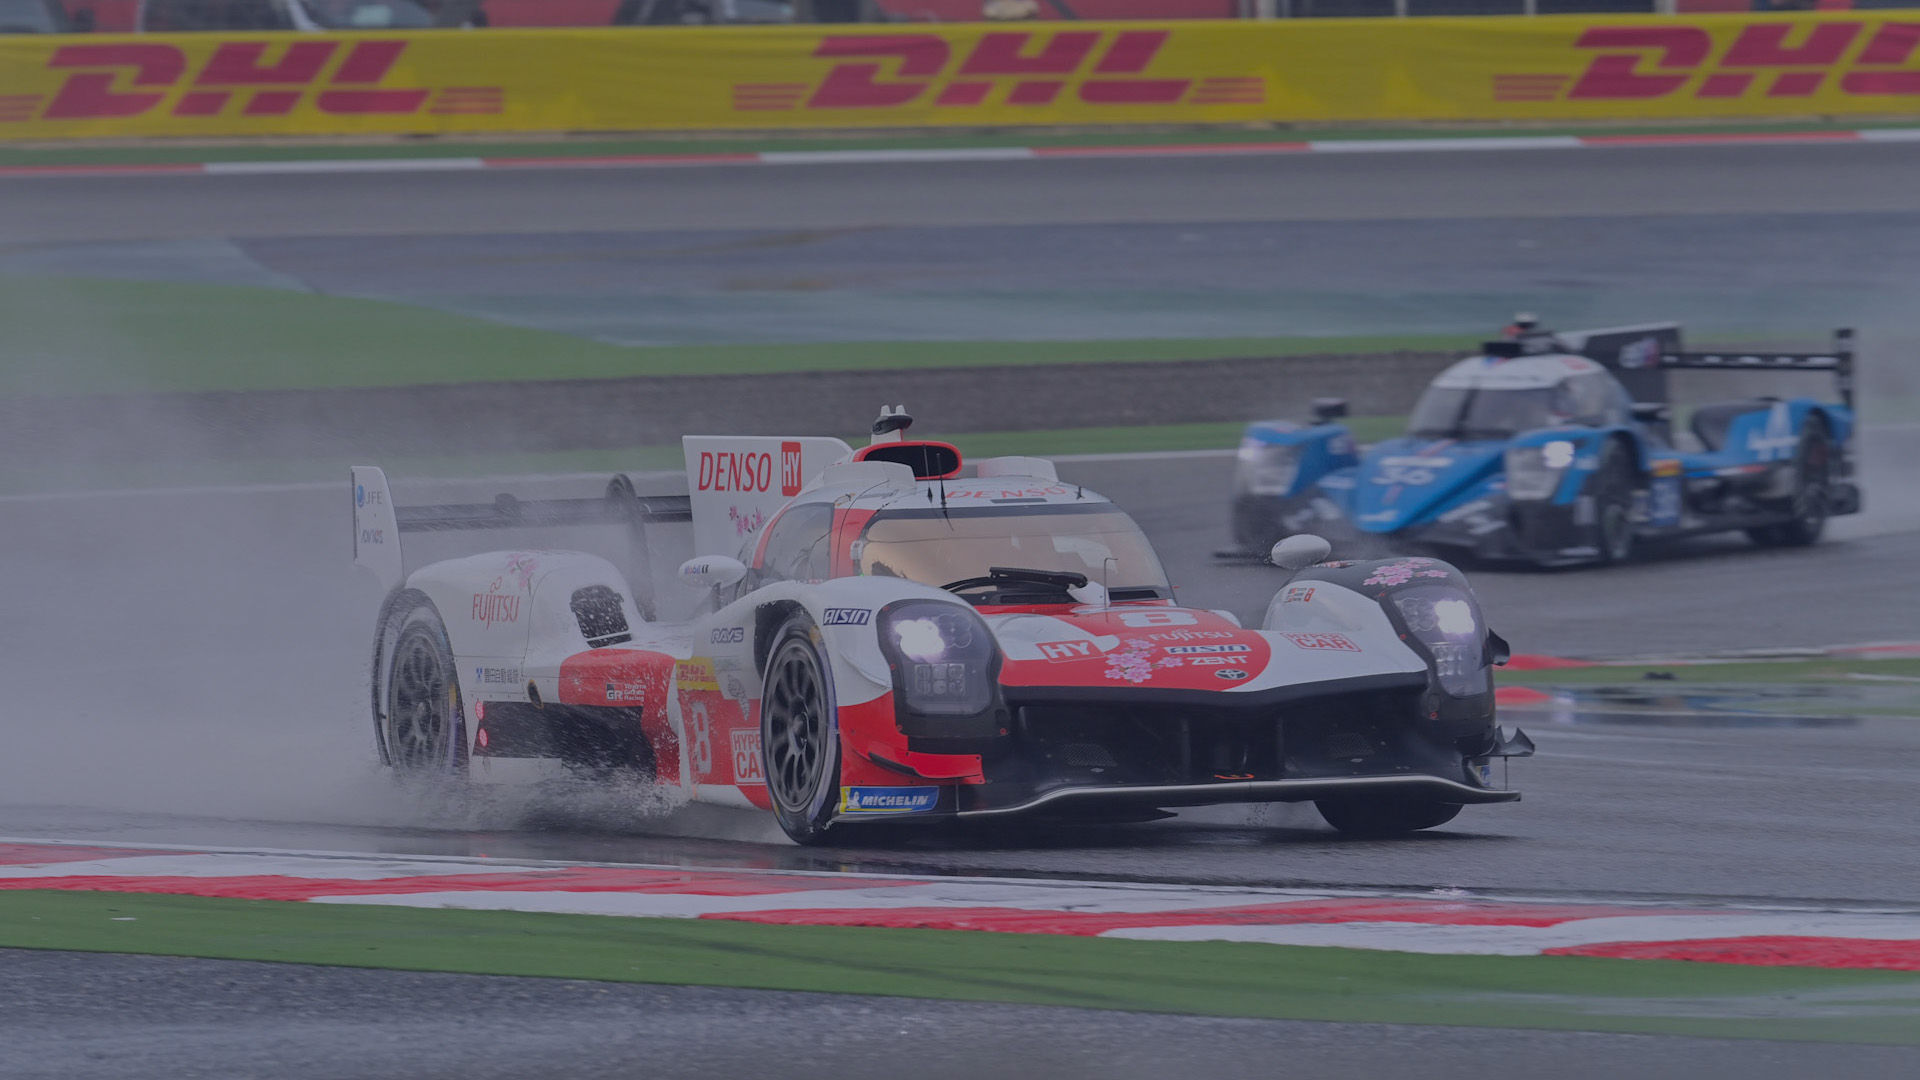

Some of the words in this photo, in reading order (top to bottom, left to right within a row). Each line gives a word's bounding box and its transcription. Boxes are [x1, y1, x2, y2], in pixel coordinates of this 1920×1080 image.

[1566, 20, 1920, 100] DHL
[806, 30, 1194, 109] DHL
[41, 40, 432, 120] DHL
[698, 451, 772, 493] DENSO
[782, 451, 801, 488] HY
[365, 491, 383, 505] JFE
[945, 486, 1067, 499] DENSO
[684, 565, 701, 575] Mobil
[1304, 587, 1315, 602] 8
[472, 592, 521, 629] FUJITSU
[824, 608, 870, 624] AISIN
[1118, 611, 1199, 628] 8
[711, 627, 744, 644] RAYS
[1147, 629, 1234, 642] FUJITSU
[1296, 638, 1355, 650] CAR
[1041, 642, 1091, 659] HY
[1169, 645, 1248, 653] AISIN
[1186, 655, 1248, 666] ZENT
[606, 690, 623, 700] GR
[691, 700, 712, 774] 8
[733, 733, 761, 751] HYPE
[736, 751, 765, 779] CA
[861, 795, 930, 806] MICHELIN
